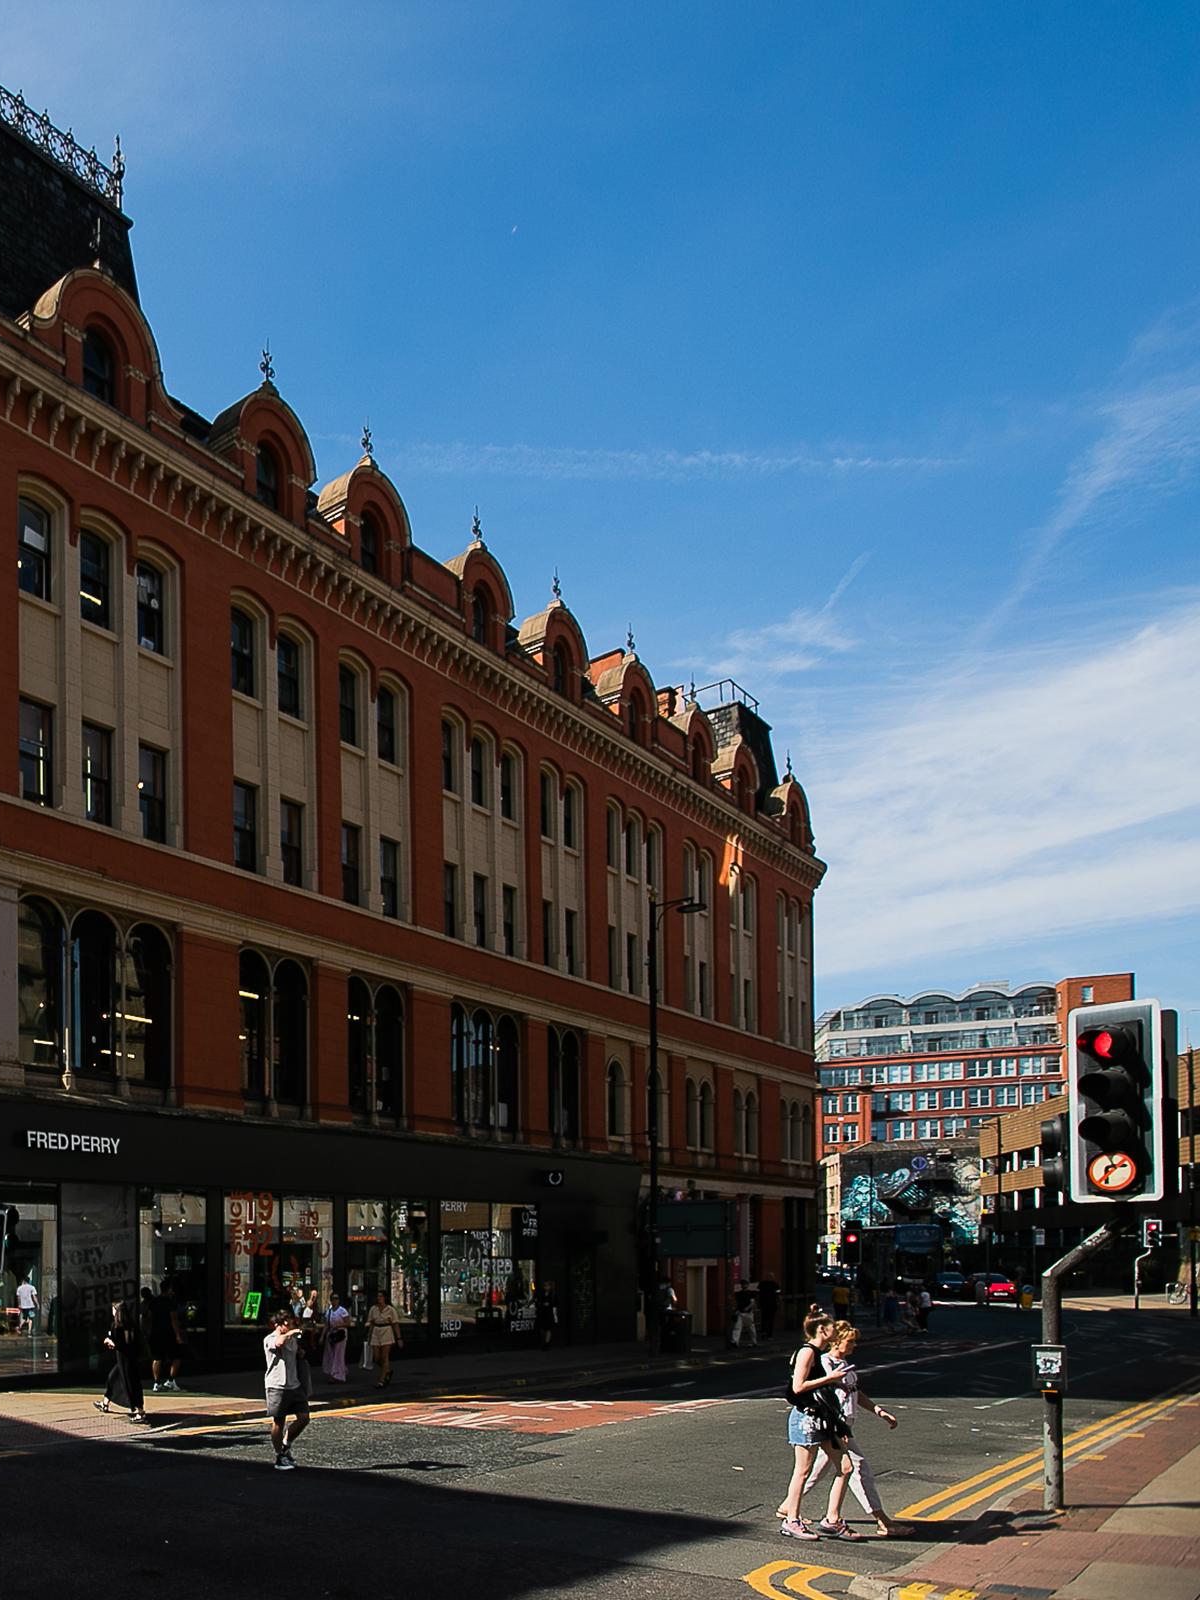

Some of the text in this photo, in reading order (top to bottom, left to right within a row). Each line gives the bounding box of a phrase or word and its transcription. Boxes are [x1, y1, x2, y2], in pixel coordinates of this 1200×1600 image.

[27, 1130, 120, 1154] FRED PERRY
[528, 1218, 538, 1229] FR
[243, 1224, 275, 1257] 52
[81, 1279, 138, 1309] FRED
[510, 1319, 536, 1332] PERRY
